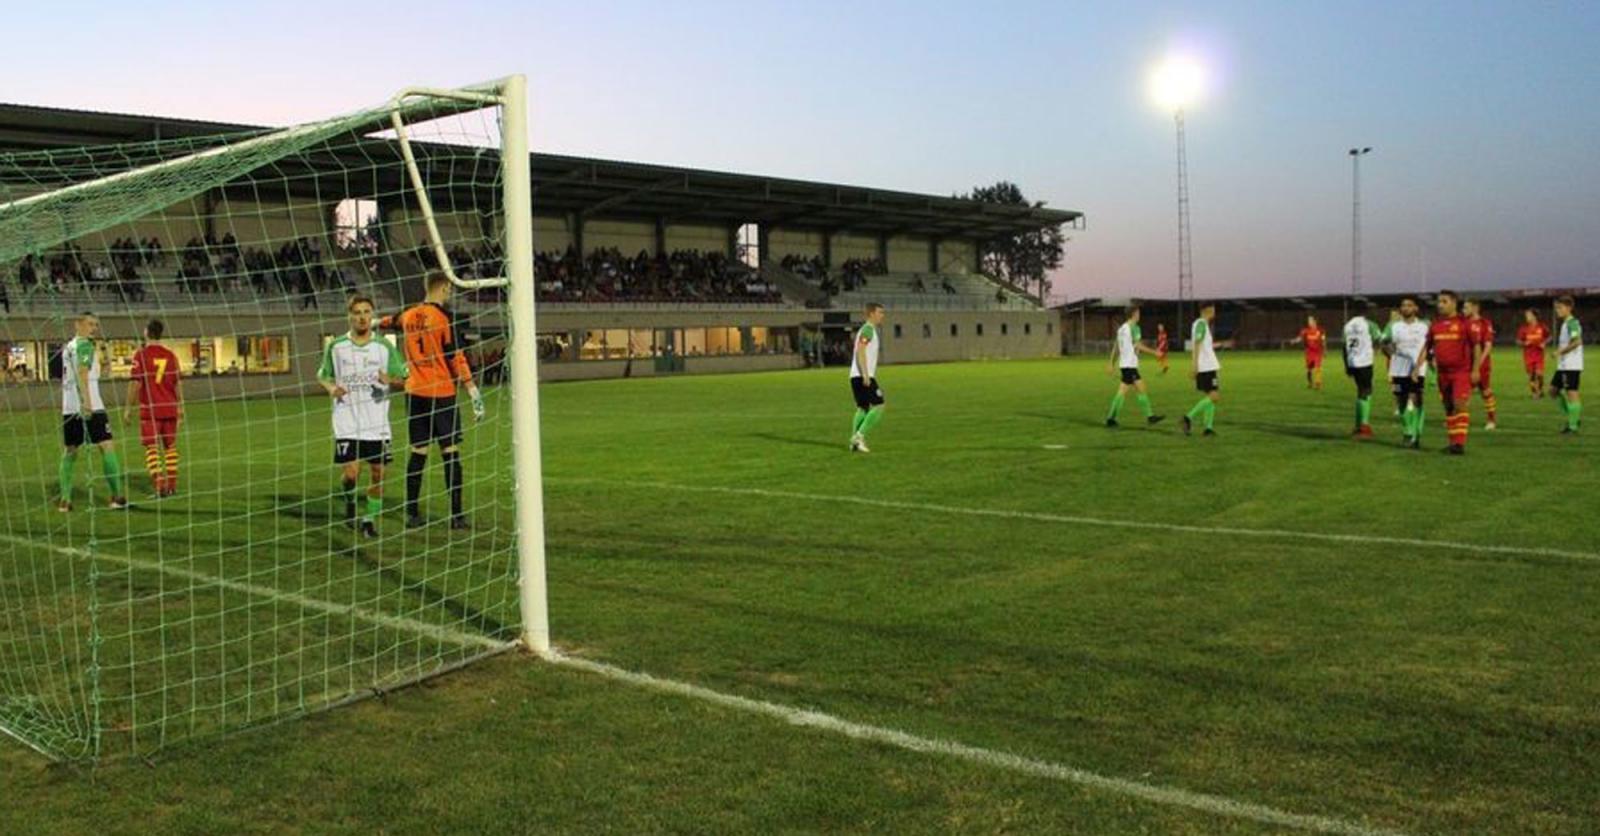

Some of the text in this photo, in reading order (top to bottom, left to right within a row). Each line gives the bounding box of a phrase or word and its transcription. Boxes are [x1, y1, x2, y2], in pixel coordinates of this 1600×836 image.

[417, 335, 425, 354] 1
[153, 358, 167, 384] 7
[336, 442, 350, 456] 17
